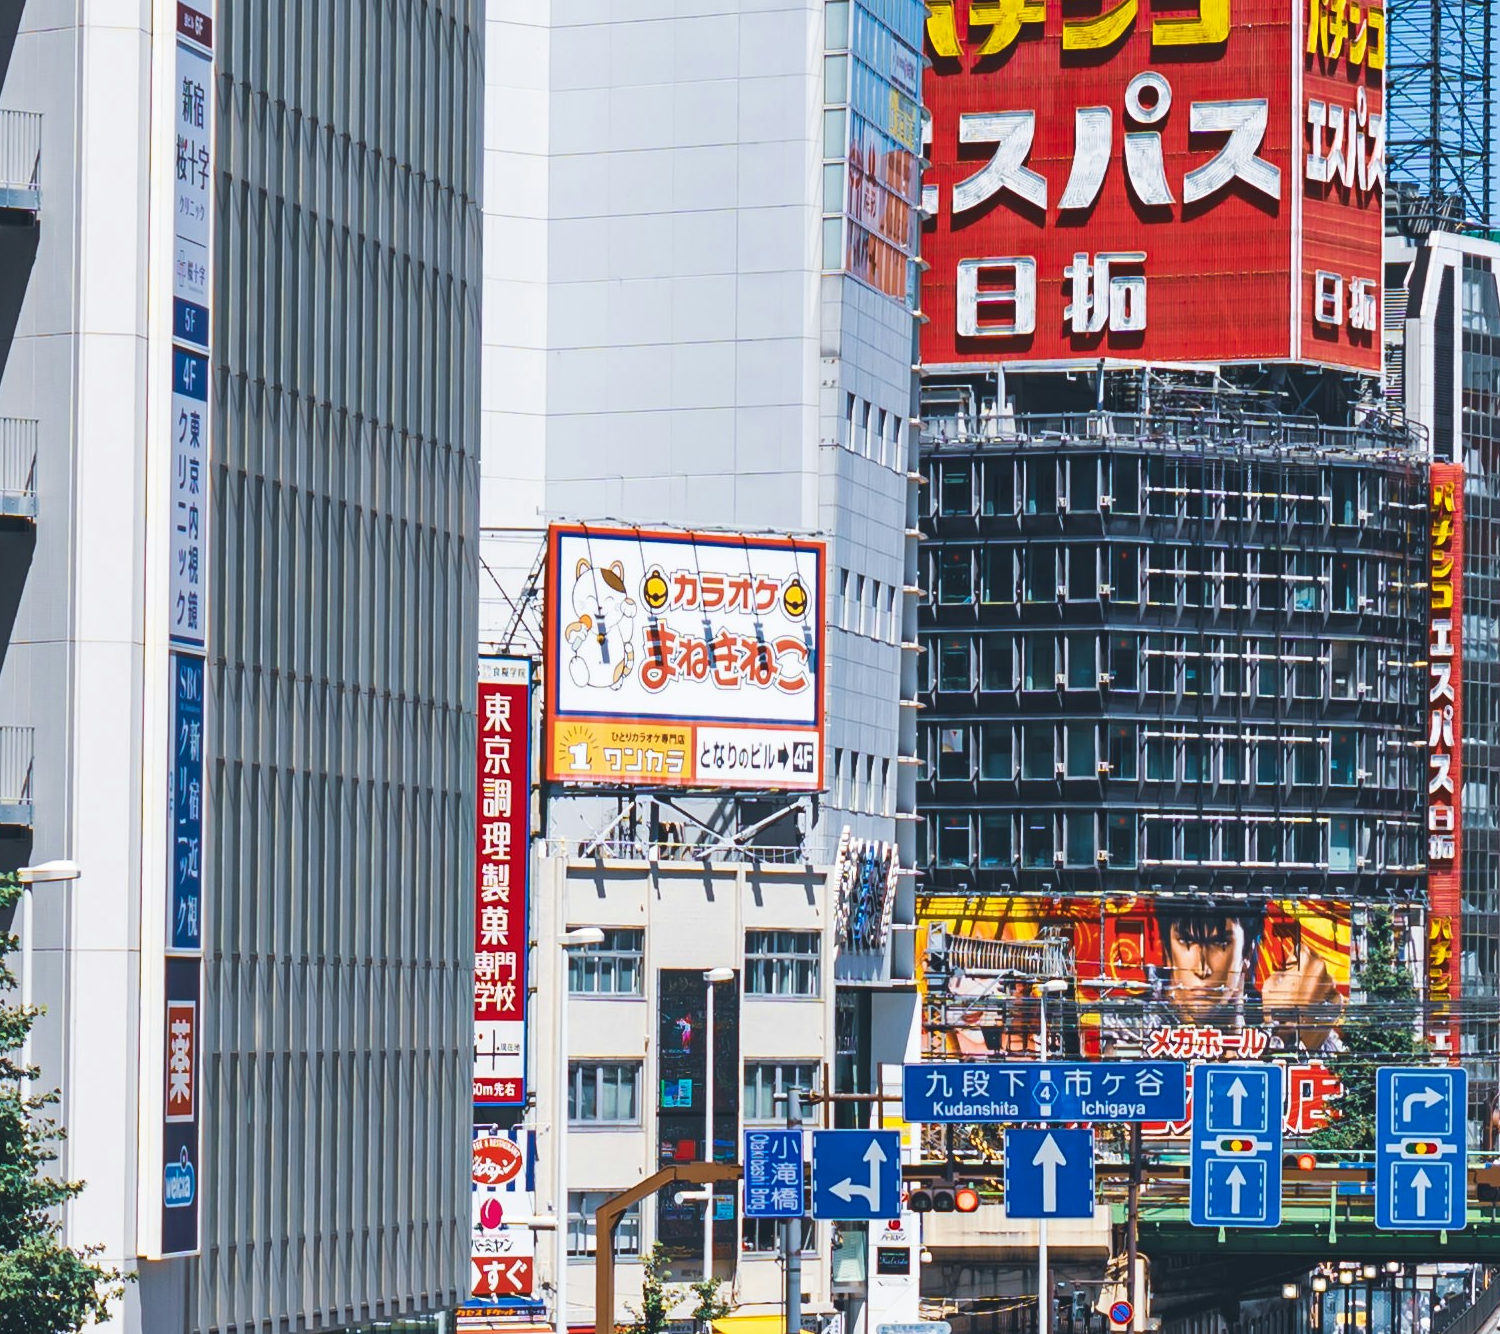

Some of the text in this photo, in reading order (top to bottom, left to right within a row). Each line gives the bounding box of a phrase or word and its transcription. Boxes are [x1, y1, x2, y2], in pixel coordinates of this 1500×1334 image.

[182, 76, 204, 129] 新宿
[176, 133, 210, 190] 桜十字
[1305, 85, 1385, 194] エスパス
[184, 307, 196, 332] 5F
[956, 250, 1148, 338] 日拓
[1314, 268, 1377, 333] 日拓
[183, 357, 196, 392] 4F
[176, 407, 188, 626] クリニック
[187, 410, 200, 630] 東京内視鏡
[1429, 480, 1455, 610] パチンコ
[674, 573, 779, 610] カラオケ
[180, 664, 201, 701] SBC
[642, 620, 810, 694] まねきねこ
[1428, 618, 1455, 795] エスパス
[603, 746, 686, 774] ワンカラ
[611, 731, 686, 746] ひとりカラオケ専門店
[699, 740, 814, 773] となりのビル 4F
[177, 716, 189, 935] クリニック
[188, 717, 200, 937] 新宿近視
[480, 692, 513, 946] 東京調理製菓
[1428, 806, 1455, 860] 日拓
[474, 950, 517, 981] 専門
[474, 981, 517, 1012] 学校
[169, 1018, 191, 1104] 薬
[1148, 1027, 1267, 1057] メガホール
[925, 1069, 1027, 1099] 九段下
[932, 1100, 1146, 1119] Kudanshita Ichigaya
[1040, 1085, 1051, 1101] 4
[748, 1134, 770, 1213] Otakibashi Brdg.
[771, 1135, 799, 1211] 小滝橋
[482, 1259, 528, 1292] すぐ
